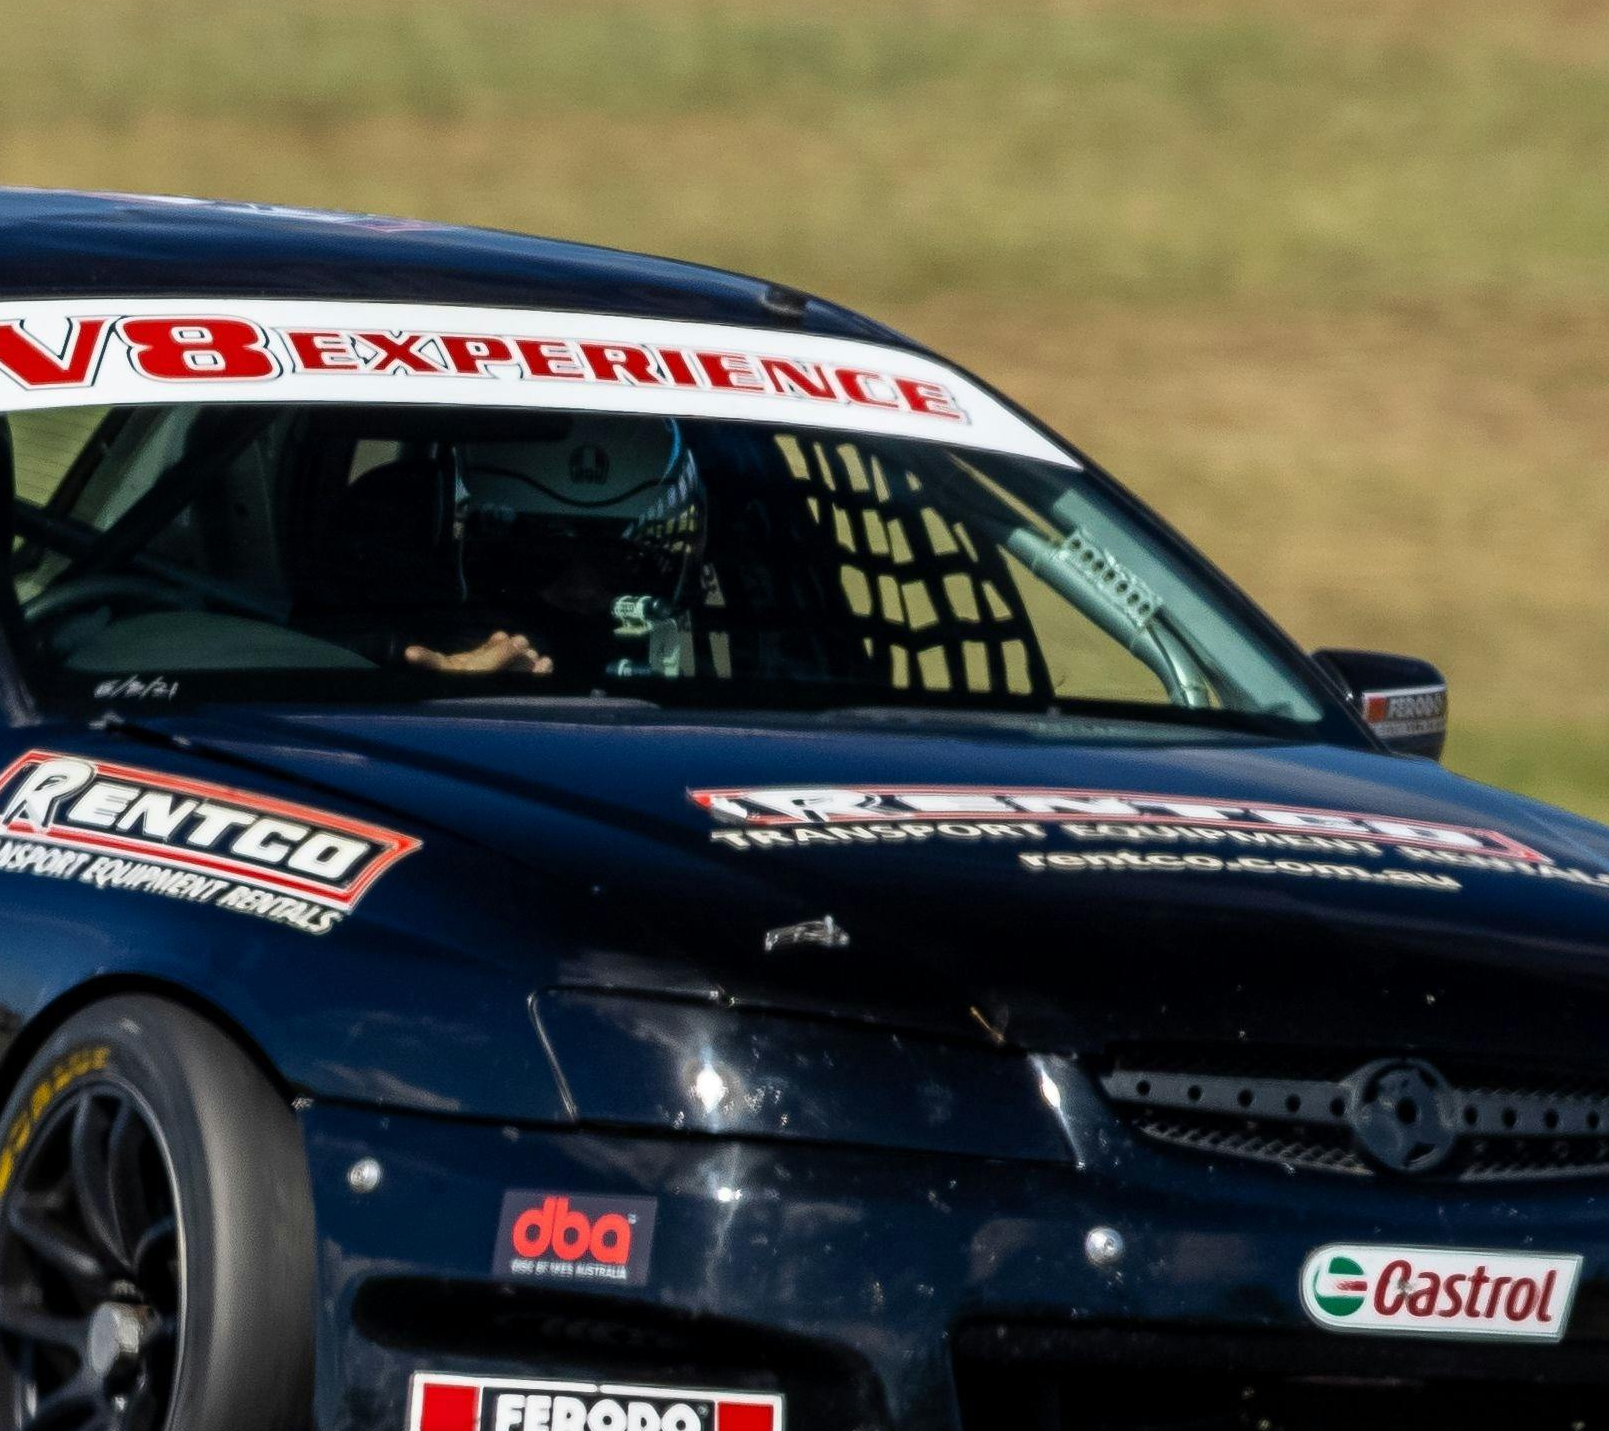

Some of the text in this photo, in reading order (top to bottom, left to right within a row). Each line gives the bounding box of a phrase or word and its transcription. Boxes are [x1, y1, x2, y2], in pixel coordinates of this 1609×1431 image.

[290, 329, 972, 424] EXPERIENCE
[1, 756, 371, 880] RENTCO
[711, 820, 1047, 852] TRANSPORT
[1057, 821, 1384, 857] EQUIPMENT
[81, 853, 232, 905] EQUIPMENT
[215, 880, 344, 935] RENTALS
[1018, 848, 1464, 893] rentco.com.au
[512, 1195, 631, 1265] dba
[1372, 1258, 1558, 1323] Castrol
